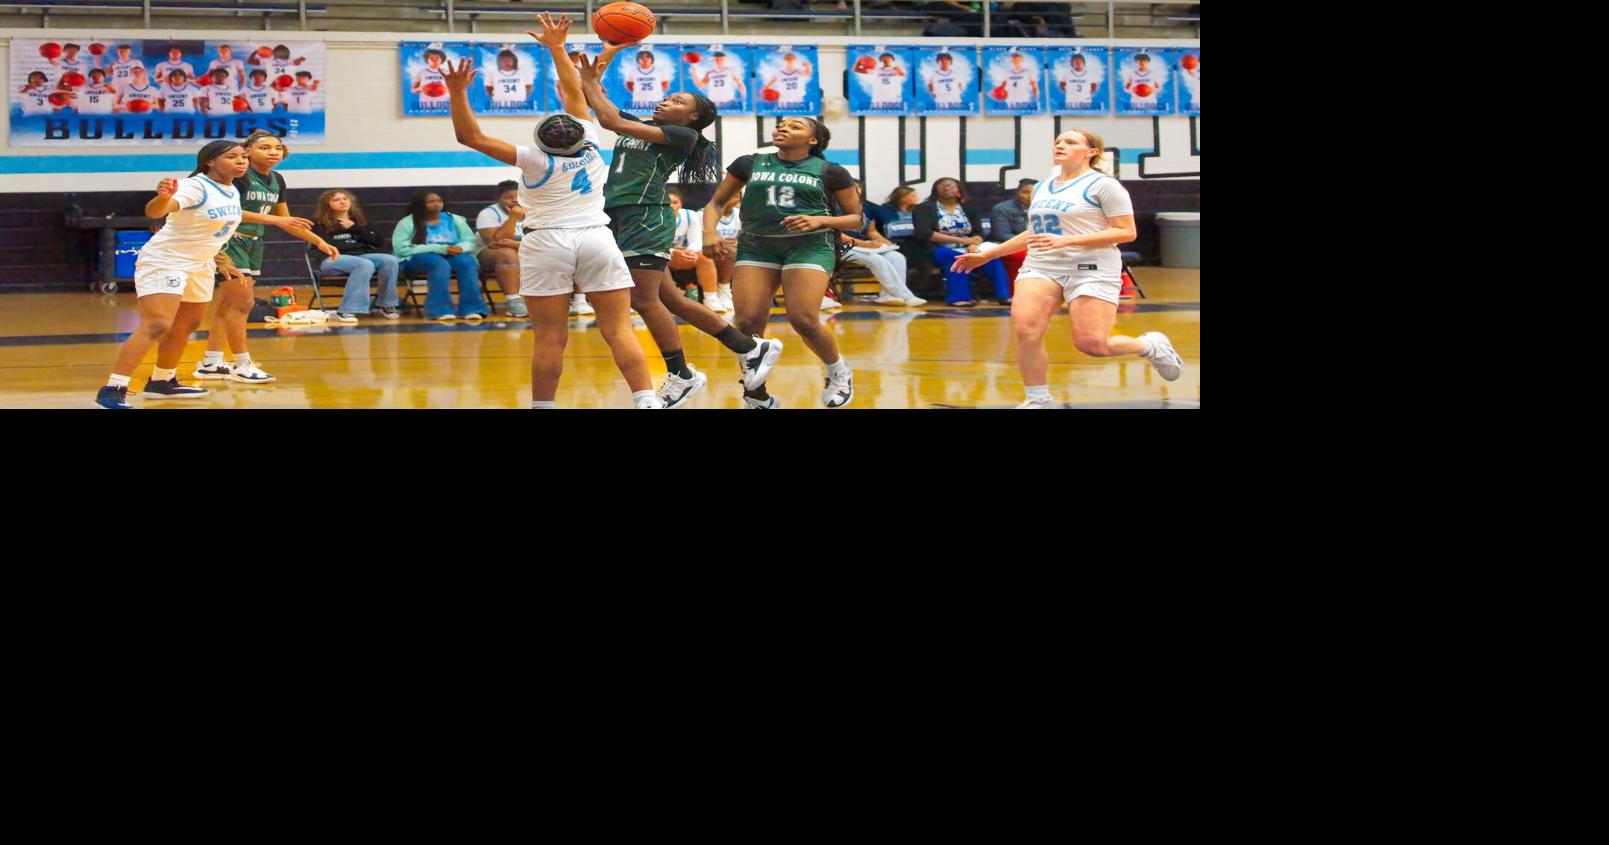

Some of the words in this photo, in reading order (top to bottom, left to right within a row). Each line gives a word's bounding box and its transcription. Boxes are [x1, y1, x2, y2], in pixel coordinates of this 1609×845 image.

[117, 70, 128, 78] 23
[503, 85, 517, 93] 34
[640, 82, 653, 91] 25
[1075, 84, 1082, 92] 3
[37, 98, 44, 106] 3
[89, 95, 99, 104] 15
[172, 99, 185, 108] 25
[44, 118, 287, 140] BULLDOGS
[614, 152, 626, 173] 1
[571, 167, 593, 195] 4
[751, 171, 776, 182] IOWA
[778, 173, 821, 187] COLONY
[246, 190, 267, 202] IOWA
[766, 186, 796, 207] 12
[1030, 213, 1063, 235] 22
